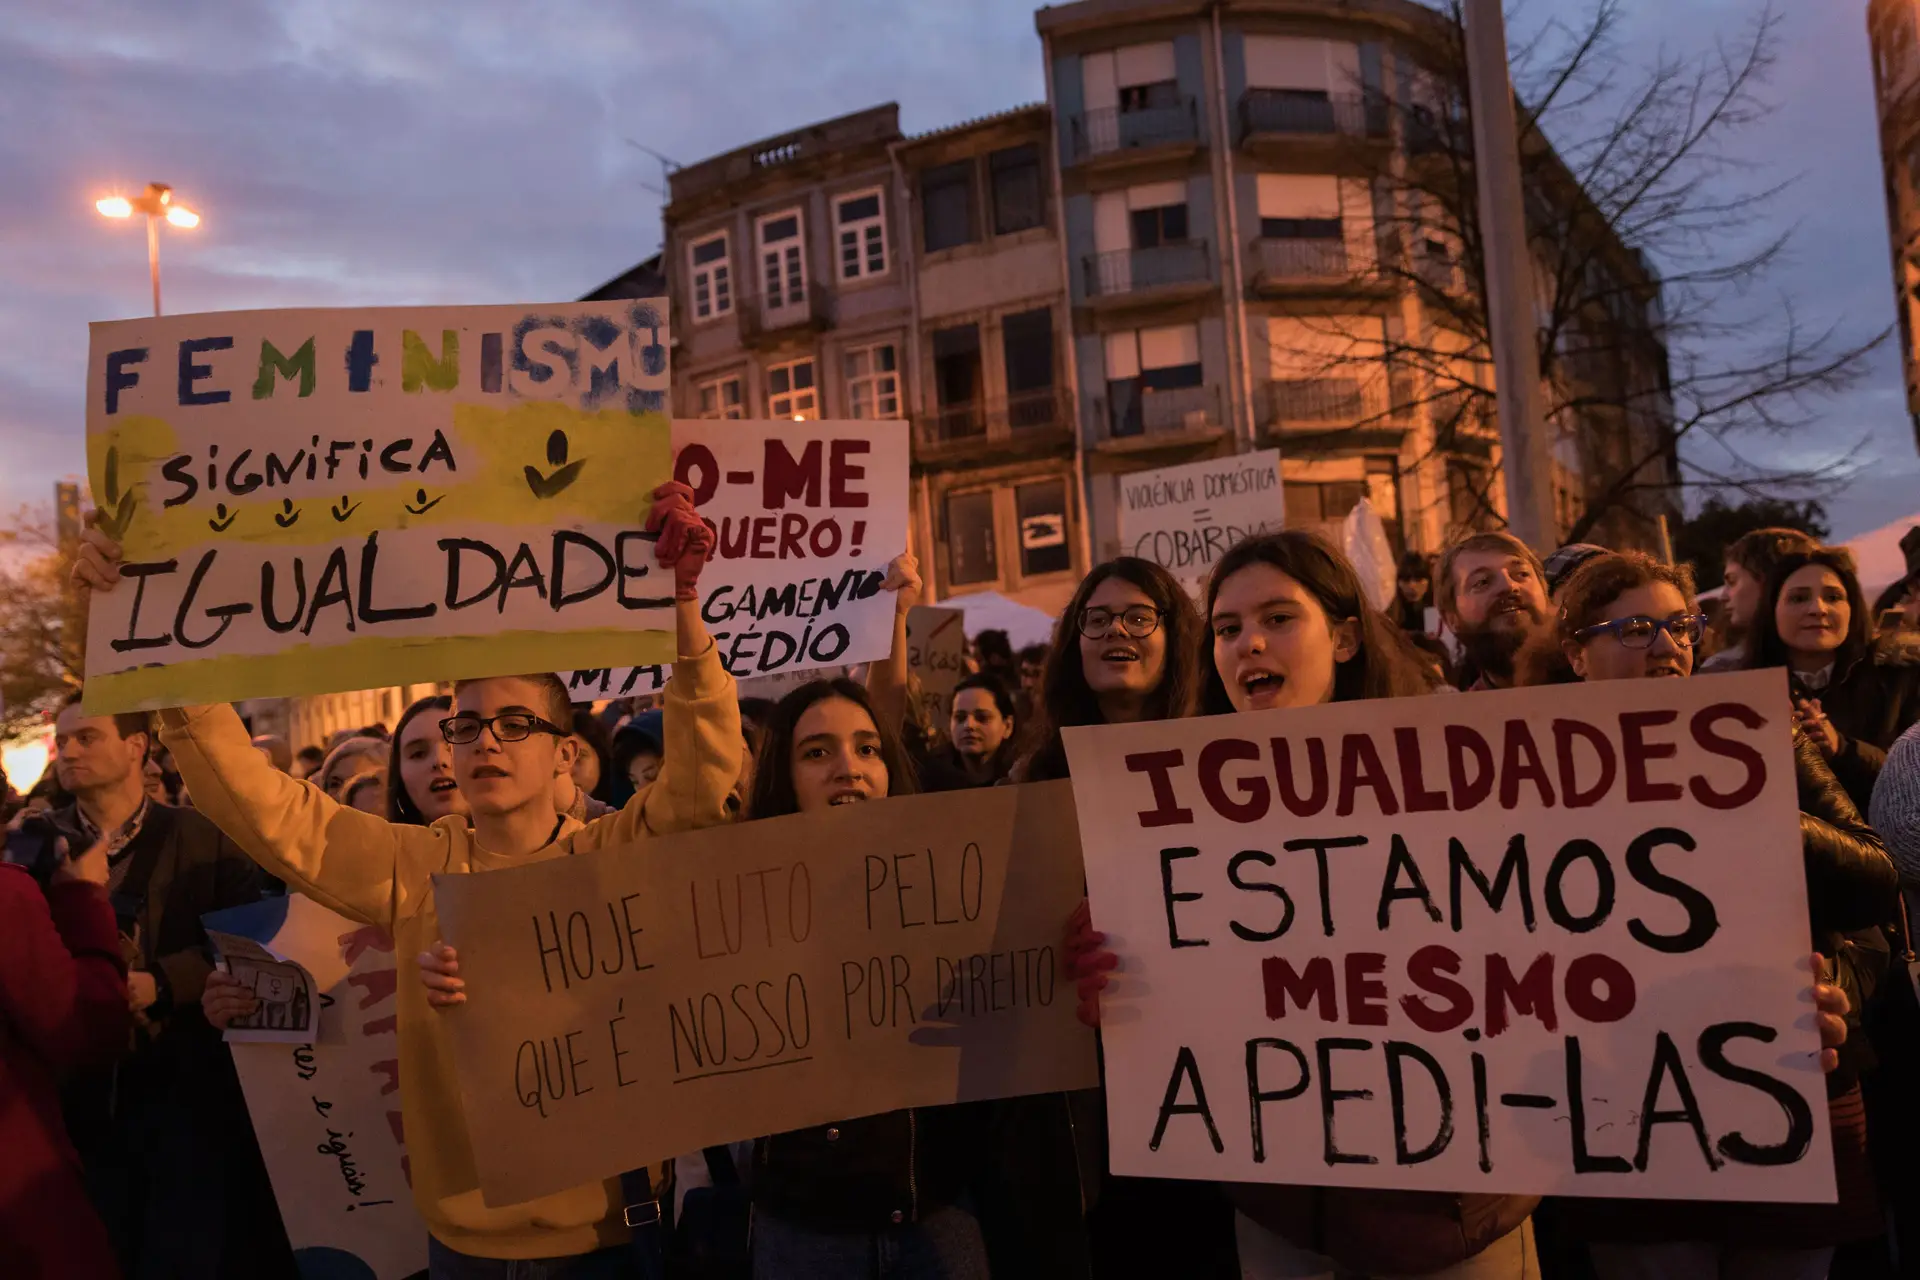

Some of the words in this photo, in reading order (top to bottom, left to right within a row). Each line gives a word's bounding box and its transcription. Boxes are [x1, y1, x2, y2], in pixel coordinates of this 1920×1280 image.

[105, 324, 671, 414] FEMINISMO
[1125, 474, 1196, 511] VIOLÊNCIA
[1204, 462, 1277, 500] DOMÉSTICA
[111, 530, 676, 652] IGUALDADE
[1125, 702, 1768, 828] IGUALDADES
[532, 893, 655, 993] HOJE
[690, 861, 814, 962] LUTO
[864, 842, 983, 930] PELO
[1160, 827, 1722, 953] ESTAMOS
[514, 1030, 594, 1119] QUE
[608, 998, 638, 1088] É
[668, 973, 812, 1075] NOSSO
[841, 954, 917, 1040] POR
[936, 945, 1055, 1019] DIREITO
[1261, 945, 1637, 1038] MESMO
